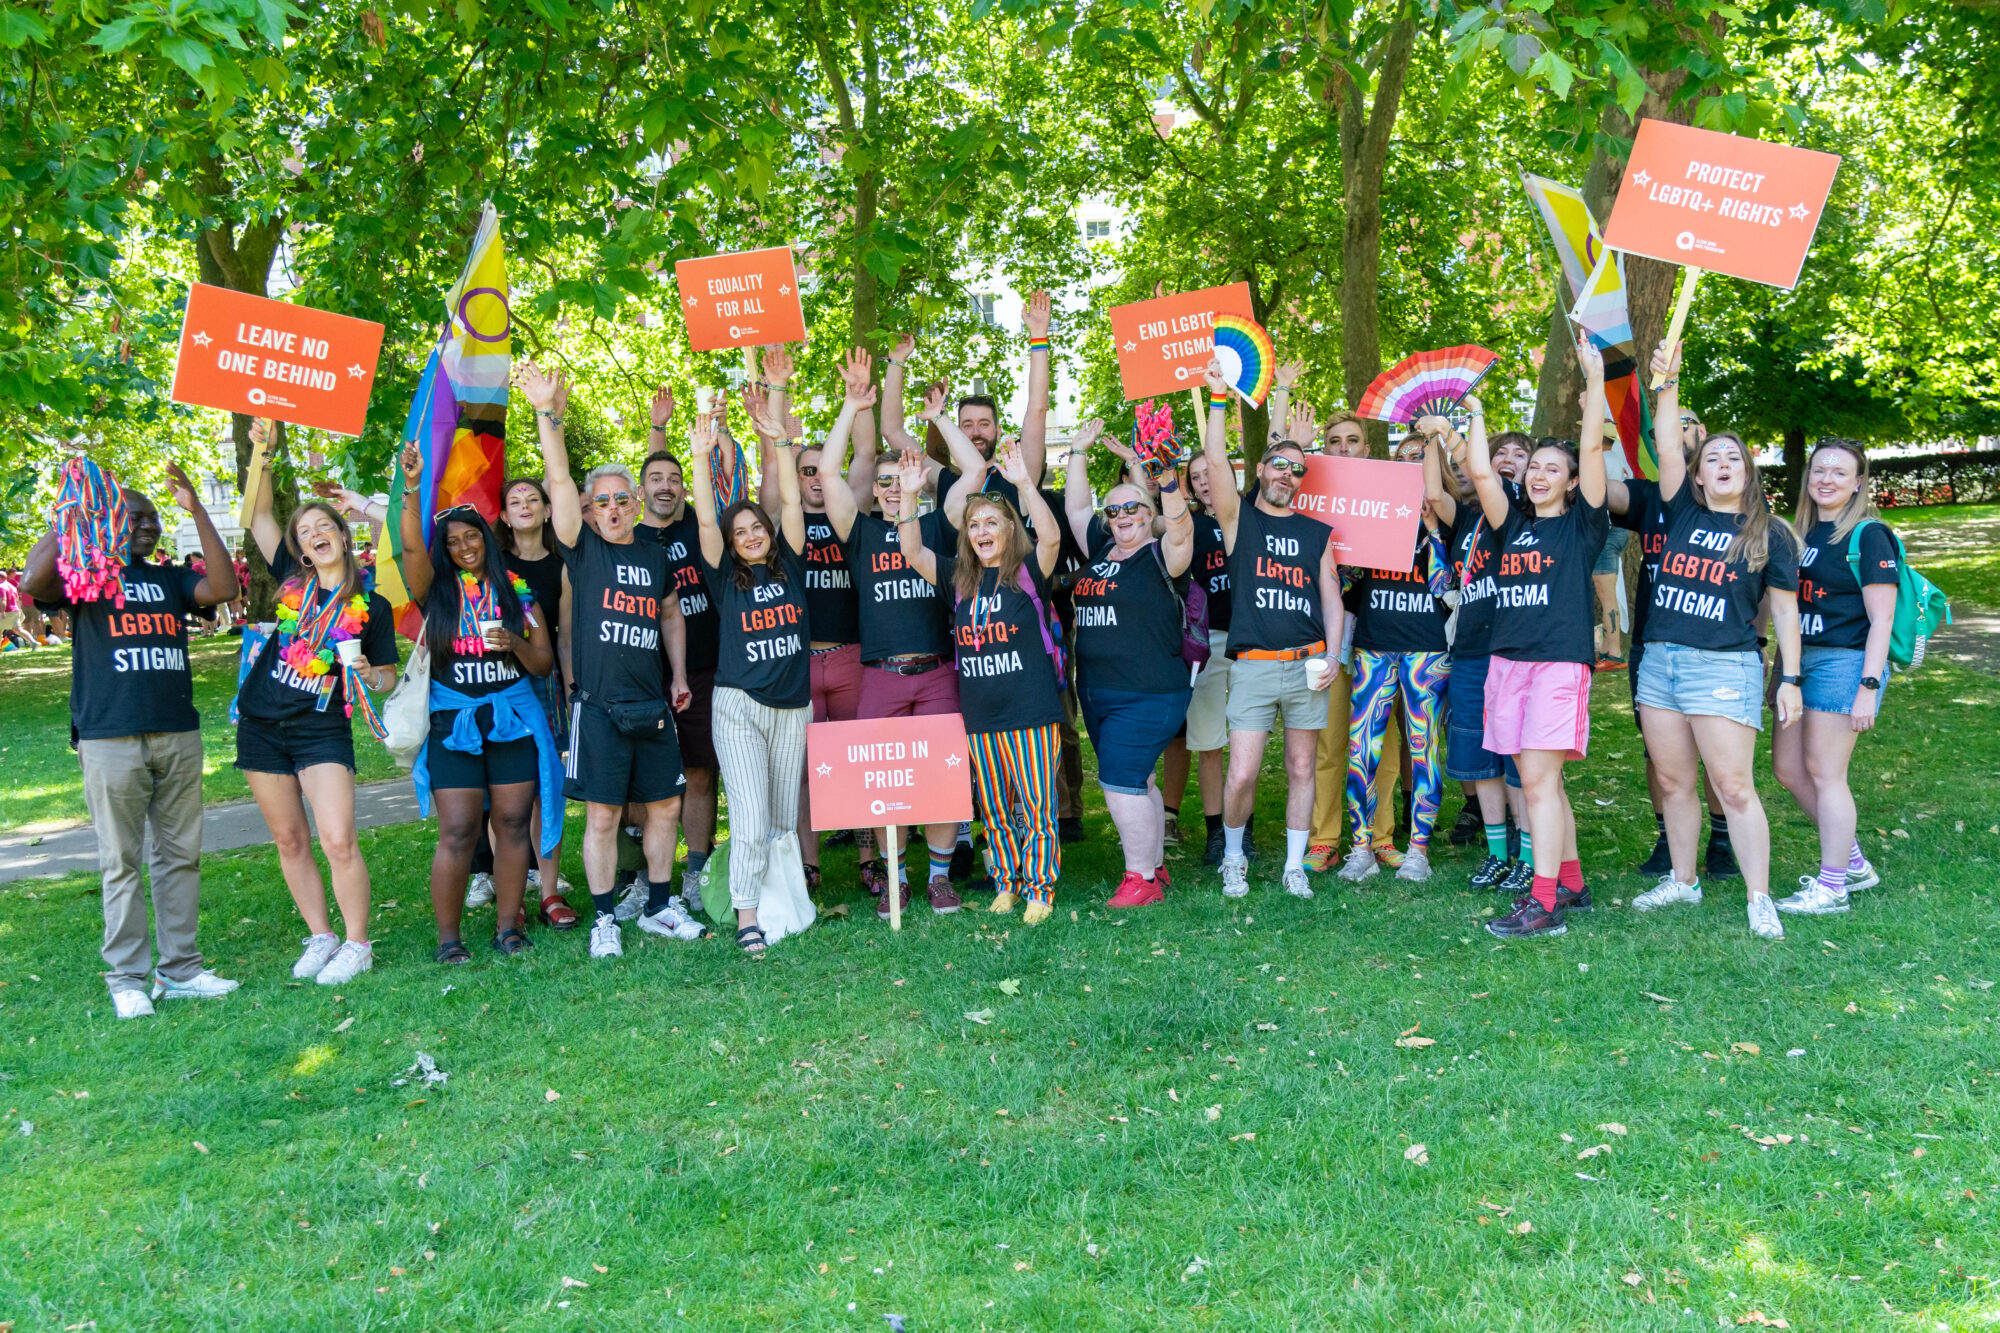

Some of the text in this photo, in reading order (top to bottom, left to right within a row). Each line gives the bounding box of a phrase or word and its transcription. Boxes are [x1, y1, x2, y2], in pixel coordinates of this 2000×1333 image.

[1685, 161, 1765, 192] PROTECT
[1649, 182, 1783, 227] LGBTQ+ RIGHTS
[707, 273, 763, 295] EQUALITY
[716, 298, 765, 318] FOR ALL
[237, 322, 329, 360] LEAVE NO
[1138, 320, 1168, 341] END
[1161, 336, 1215, 360] STIGMA
[217, 350, 337, 391] ONE BEHIND
[1331, 496, 1347, 514] IS
[1350, 499, 1390, 519] LOVE
[667, 541, 688, 562] ND
[1265, 534, 1299, 556] END
[1688, 528, 1733, 552] END
[616, 564, 652, 586] END
[1499, 550, 1555, 576] GBTQ+
[1662, 550, 1738, 587] LGBTQ+
[805, 569, 851, 589] TIGMA
[873, 578, 936, 602] STIGMA
[1075, 577, 1119, 597] GBTQ+
[125, 582, 165, 603] END
[602, 587, 660, 619] LGBTQ+
[680, 592, 709, 617] GMA
[753, 582, 784, 603] END
[1370, 589, 1435, 613] STIGMA
[1654, 583, 1726, 621] STIGMA
[108, 613, 183, 637] LGBTQ+
[741, 603, 803, 632] LGBTQ+
[1077, 605, 1118, 627] TIGMA
[599, 620, 659, 651] STIGMA
[114, 647, 185, 673] STIGMA
[453, 660, 520, 684] STIGMA
[961, 650, 1023, 678] STIGMA
[847, 740, 929, 763] UNITED IN
[864, 768, 915, 789] PRIDE
